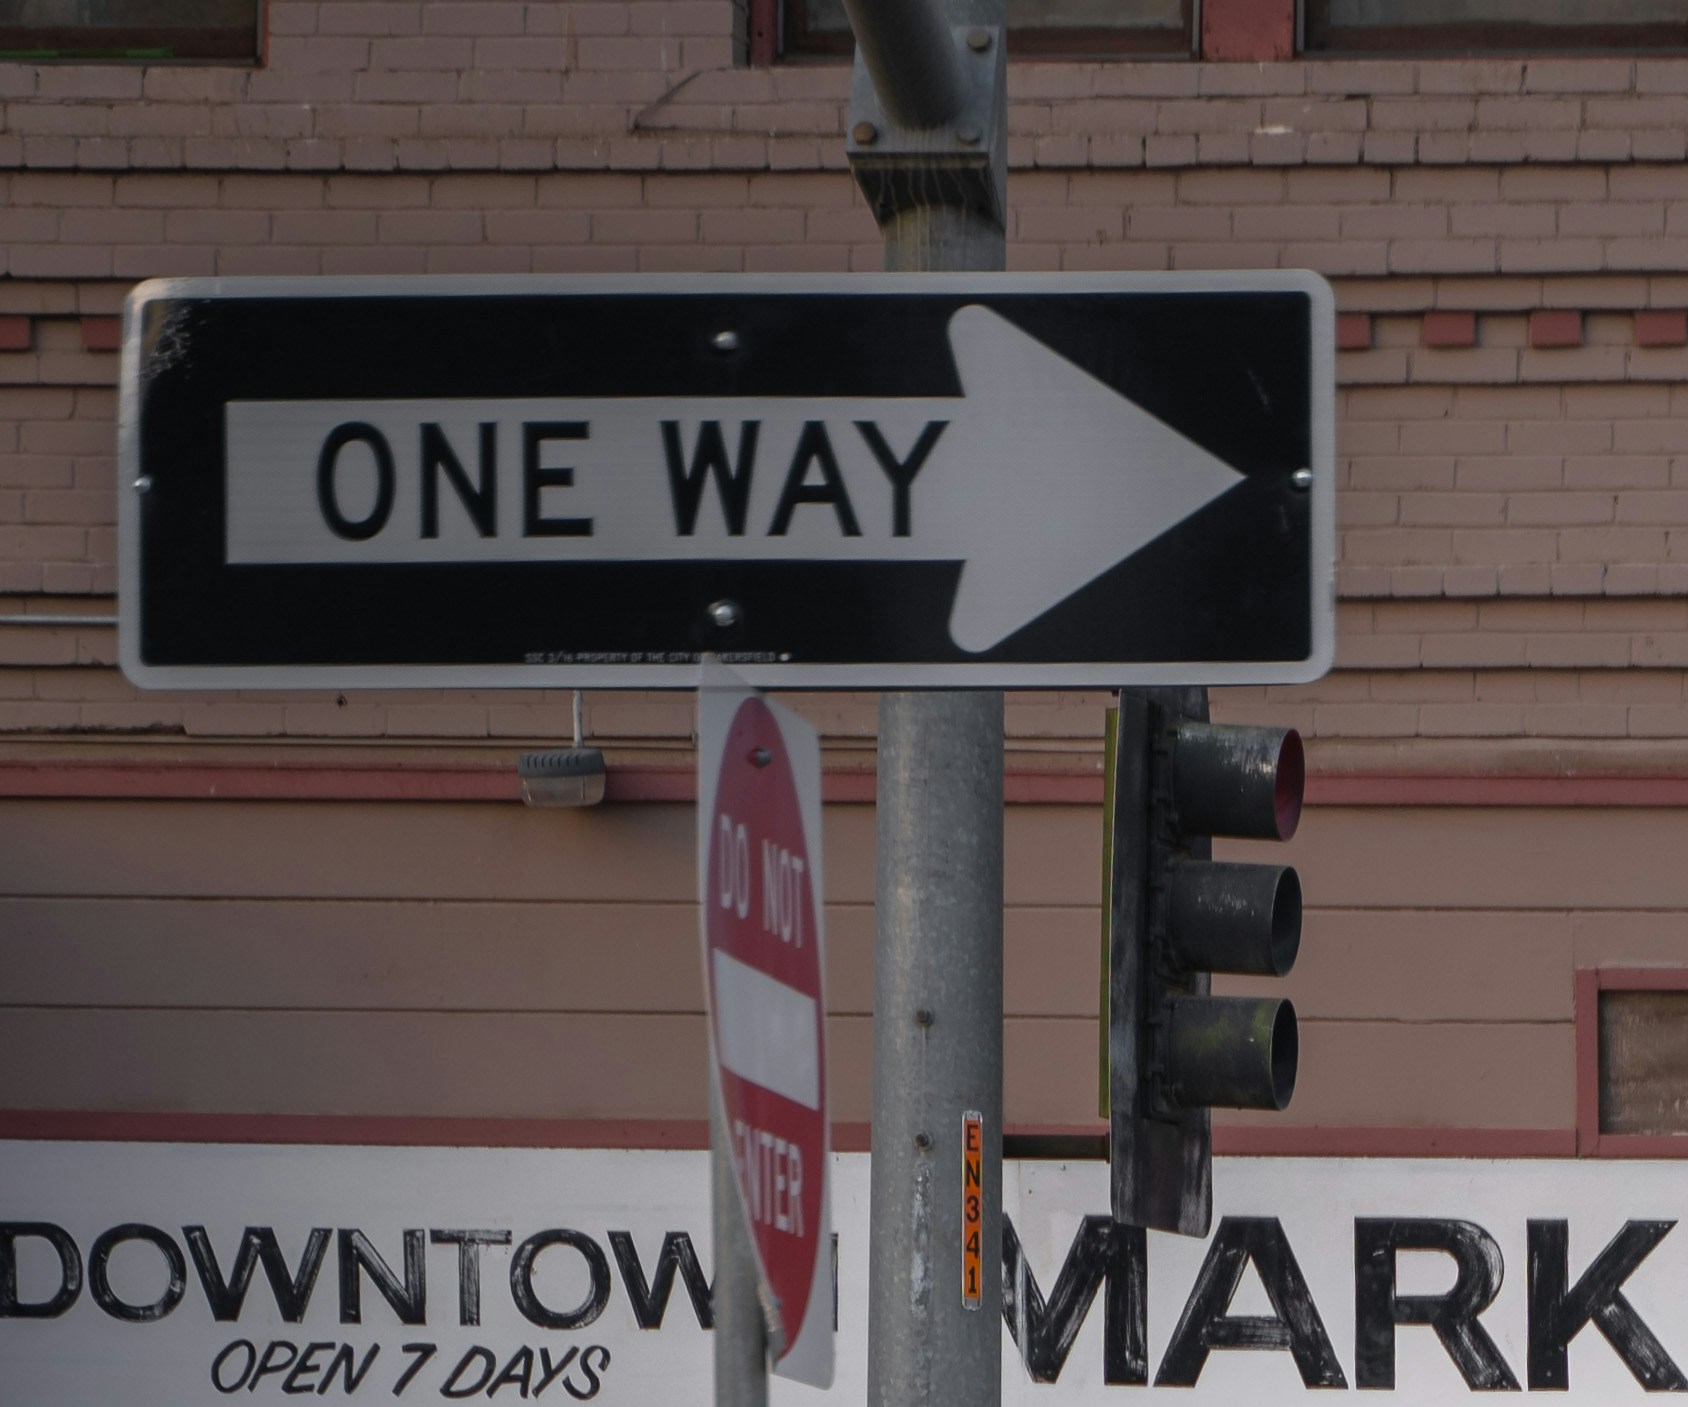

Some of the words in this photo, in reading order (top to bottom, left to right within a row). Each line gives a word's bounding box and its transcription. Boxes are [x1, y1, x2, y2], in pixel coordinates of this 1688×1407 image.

[315, 420, 594, 539] ONE
[661, 419, 950, 537] WAY
[576, 651, 628, 664] PROPERTY
[631, 651, 644, 664] OF
[646, 651, 665, 664] THE
[669, 651, 690, 664] CITY
[718, 813, 750, 919] DO
[762, 839, 804, 949] NOT
[733, 1119, 804, 1237] ENTER
[965, 1125, 981, 1294] EN341
[0, 1221, 838, 1332] DOWNTOW
[210, 1337, 381, 1397] OPEN
[393, 1341, 437, 1398] 7
[442, 1342, 612, 1401] DAYS
